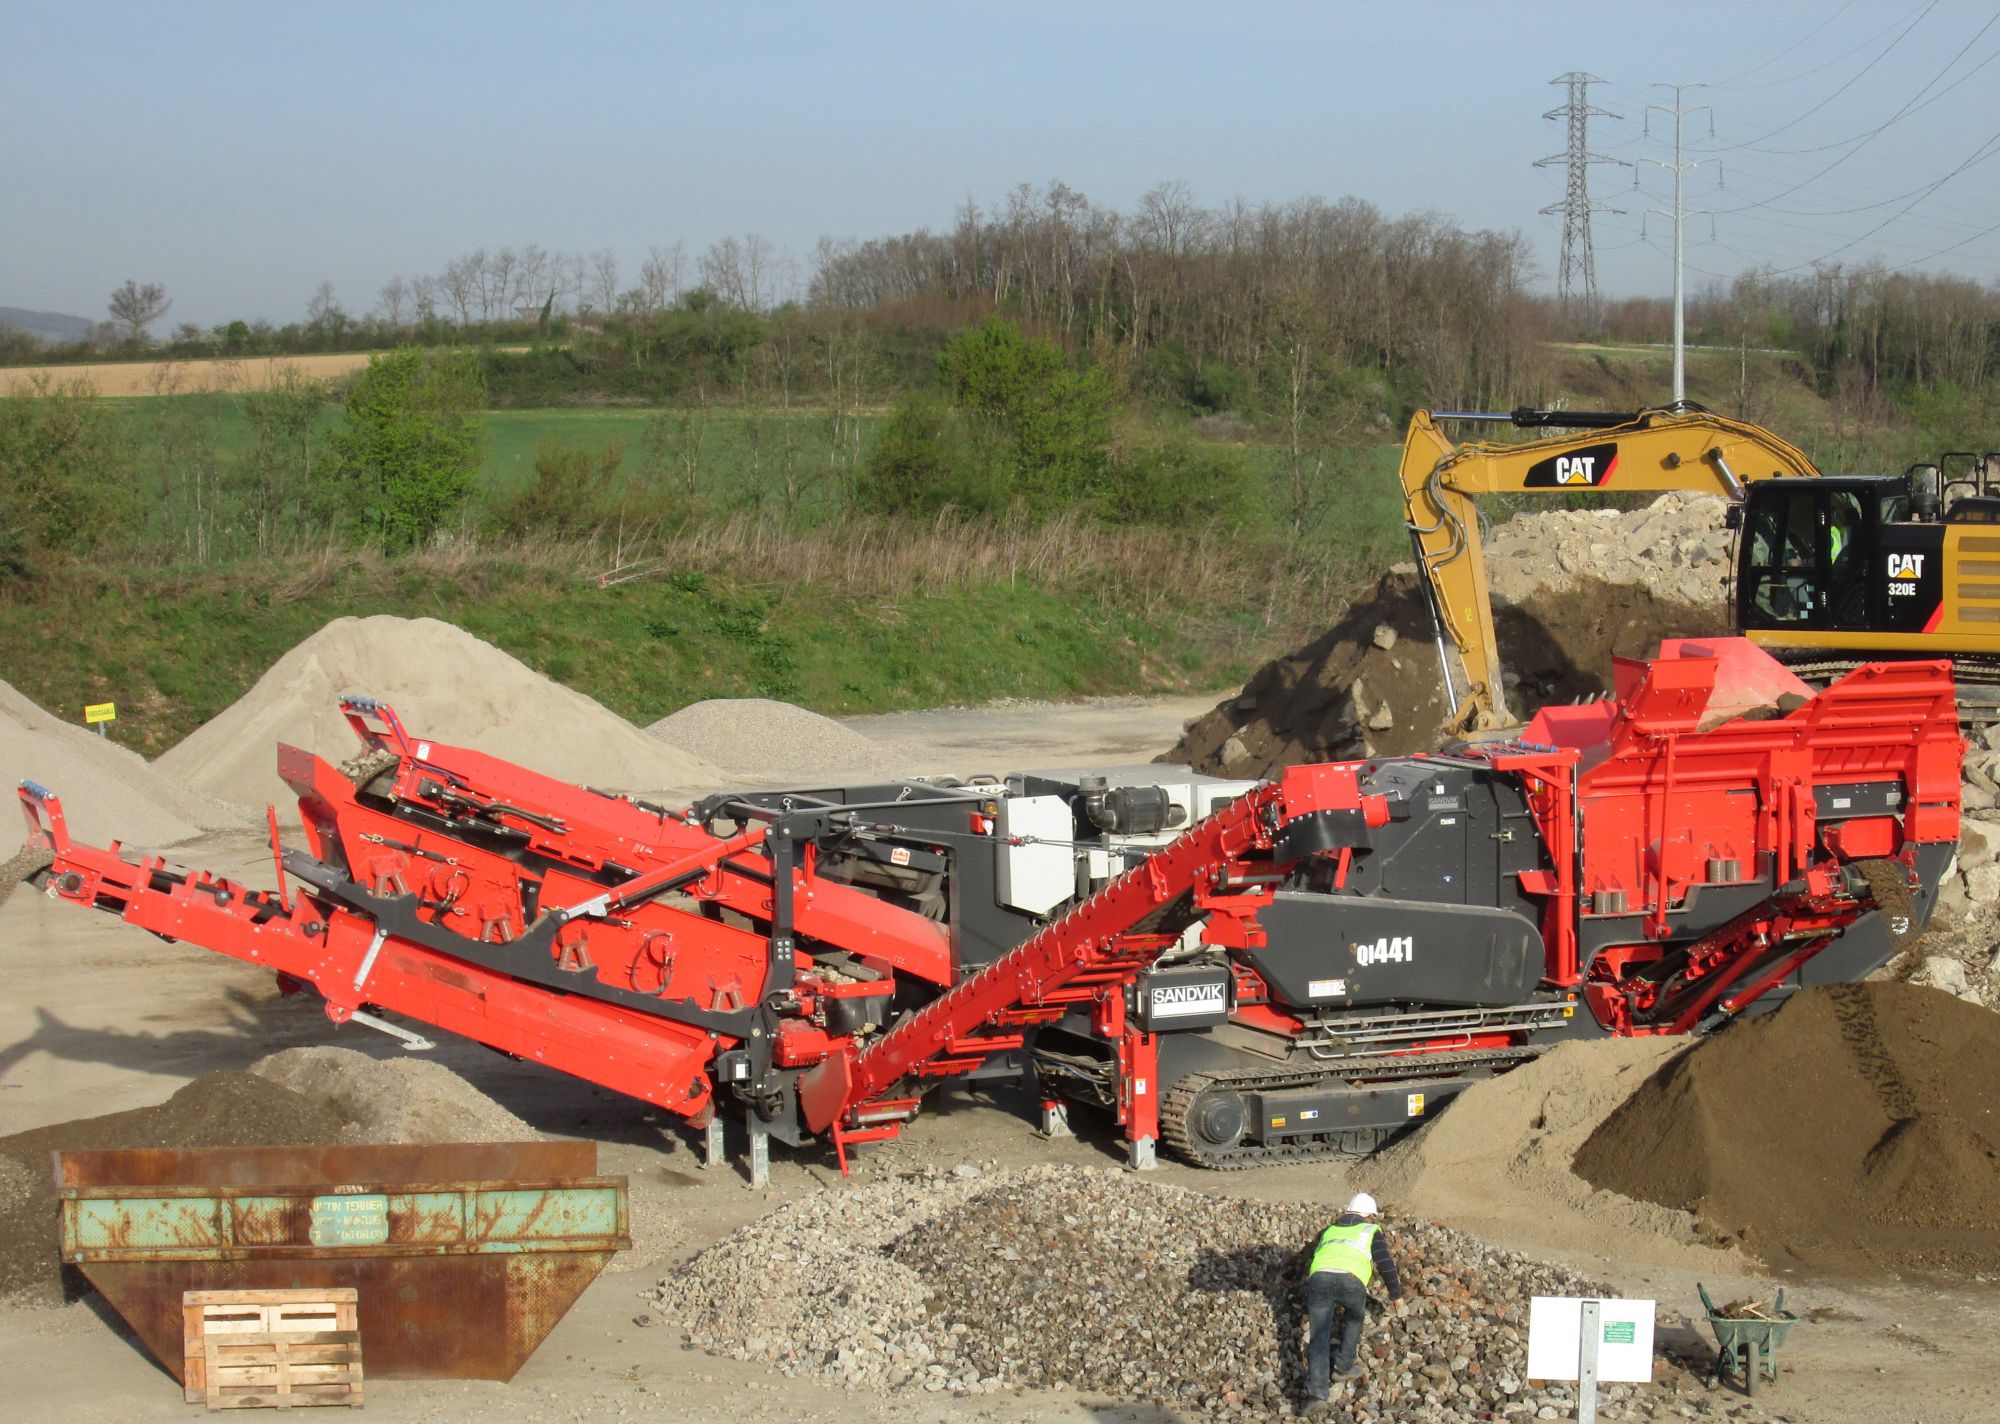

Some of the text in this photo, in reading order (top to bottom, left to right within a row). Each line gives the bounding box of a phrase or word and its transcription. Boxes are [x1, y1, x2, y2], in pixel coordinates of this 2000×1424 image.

[1556, 456, 1595, 484] CAT
[1887, 553, 1925, 578] CAT
[1888, 583, 1916, 595] 320E
[1356, 936, 1413, 966] QI441
[1153, 985, 1223, 1004] SANDVIK
